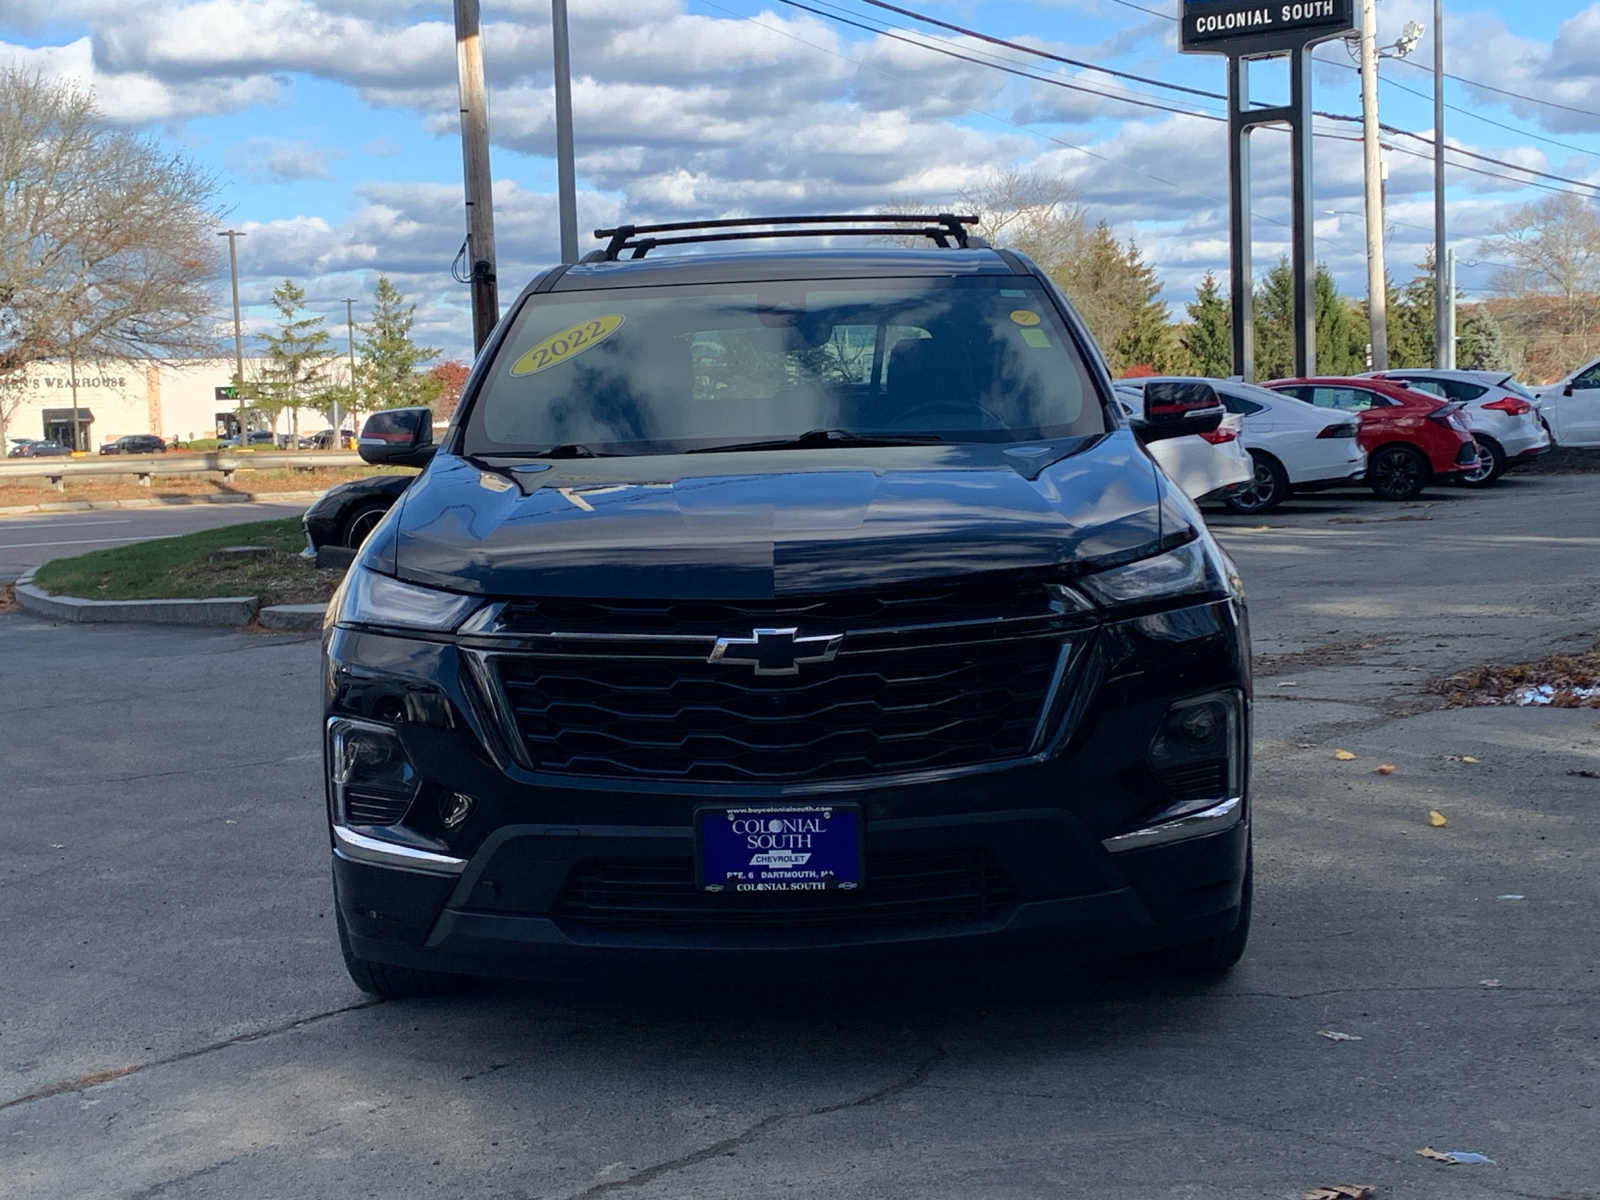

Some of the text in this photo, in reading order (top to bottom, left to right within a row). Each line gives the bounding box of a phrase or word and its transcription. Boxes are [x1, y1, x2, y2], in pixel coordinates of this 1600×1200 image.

[1196, 0, 1334, 33] COLONIAL SOUTH
[532, 321, 606, 368] 2022
[44, 377, 126, 389] WEARHOUSE
[726, 806, 833, 815] www.buycolonialsouth.com
[732, 818, 826, 834] COLONIAL
[747, 834, 812, 849] SOUTH
[755, 854, 807, 863] CHEVROLET
[748, 871, 754, 879] 6
[736, 882, 826, 892] COLONIAL SOUTH
